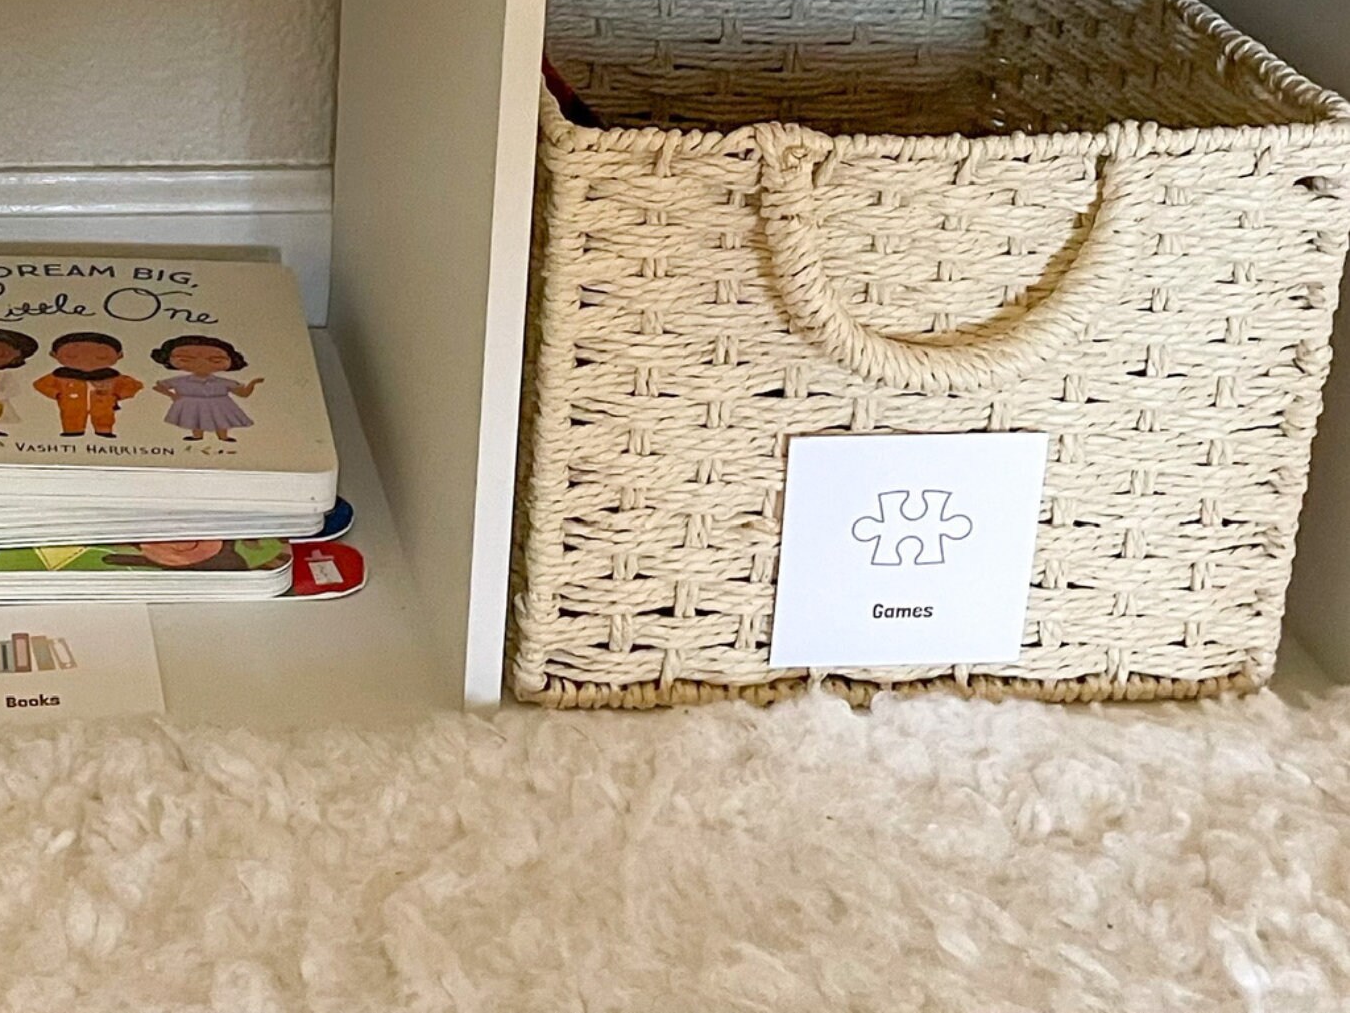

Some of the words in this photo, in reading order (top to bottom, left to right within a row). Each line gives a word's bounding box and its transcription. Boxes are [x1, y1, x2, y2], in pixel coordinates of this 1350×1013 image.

[132, 267, 199, 288] BIG,
[103, 287, 219, 325] One
[15, 441, 77, 454] VASHTI
[86, 443, 175, 456] HARRISON
[872, 602, 934, 620] Games
[5, 693, 61, 708] Books
